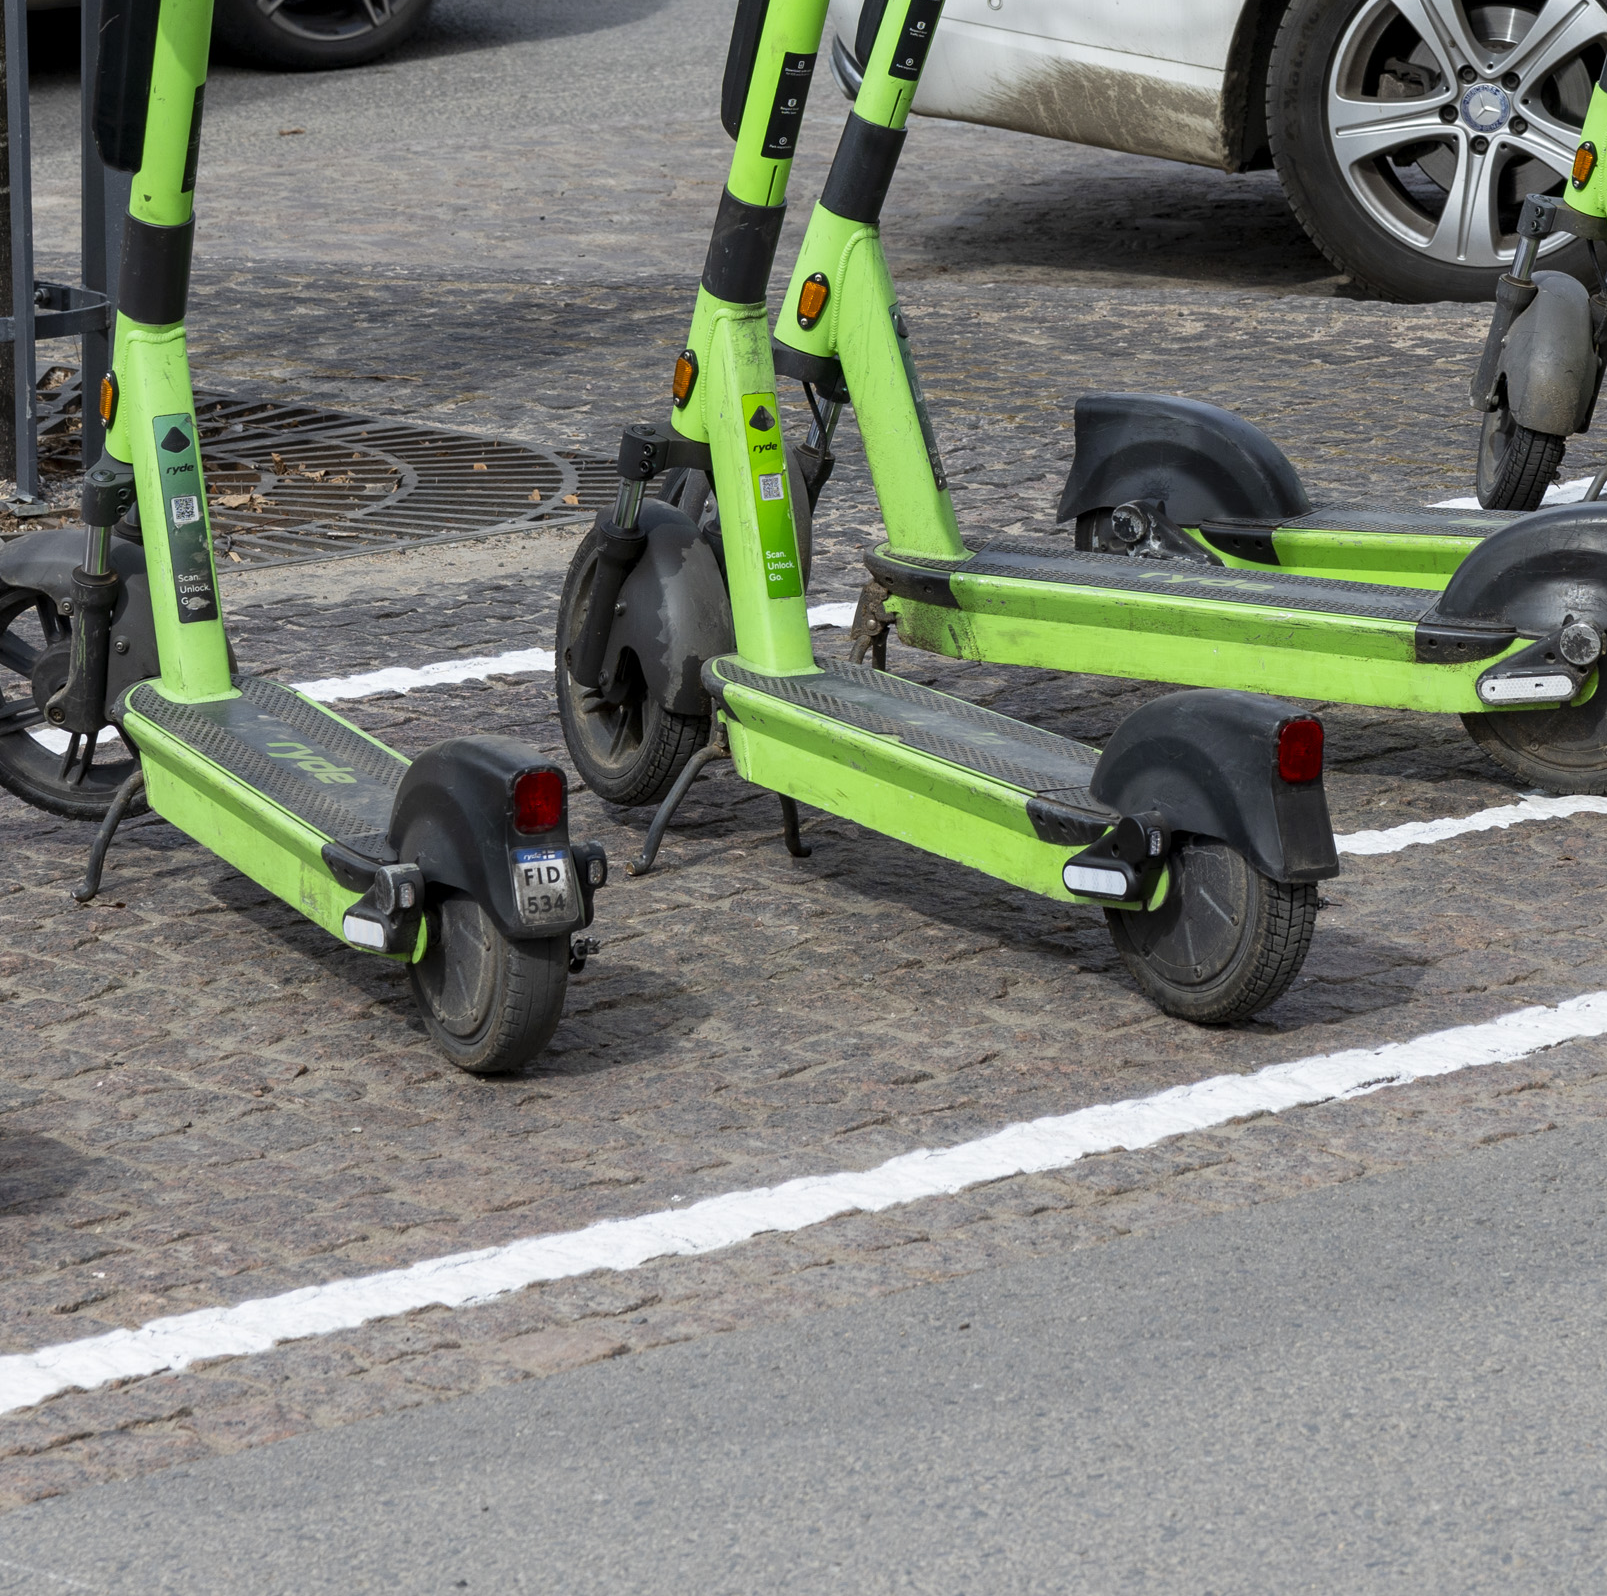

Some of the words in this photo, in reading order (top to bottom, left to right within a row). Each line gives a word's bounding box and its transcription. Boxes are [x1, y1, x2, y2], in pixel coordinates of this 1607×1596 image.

[753, 442, 778, 454] ryde
[166, 463, 195, 475] ryde
[766, 550, 787, 559] Scan.
[767, 561, 795, 570] Unlock.
[768, 572, 783, 582] Go.
[1137, 572, 1275, 592] ryde
[179, 585, 211, 594] Unlock.
[265, 742, 358, 784] ryde
[523, 852, 542, 861] ryde
[523, 866, 561, 887] FID
[527, 893, 567, 915] 534
